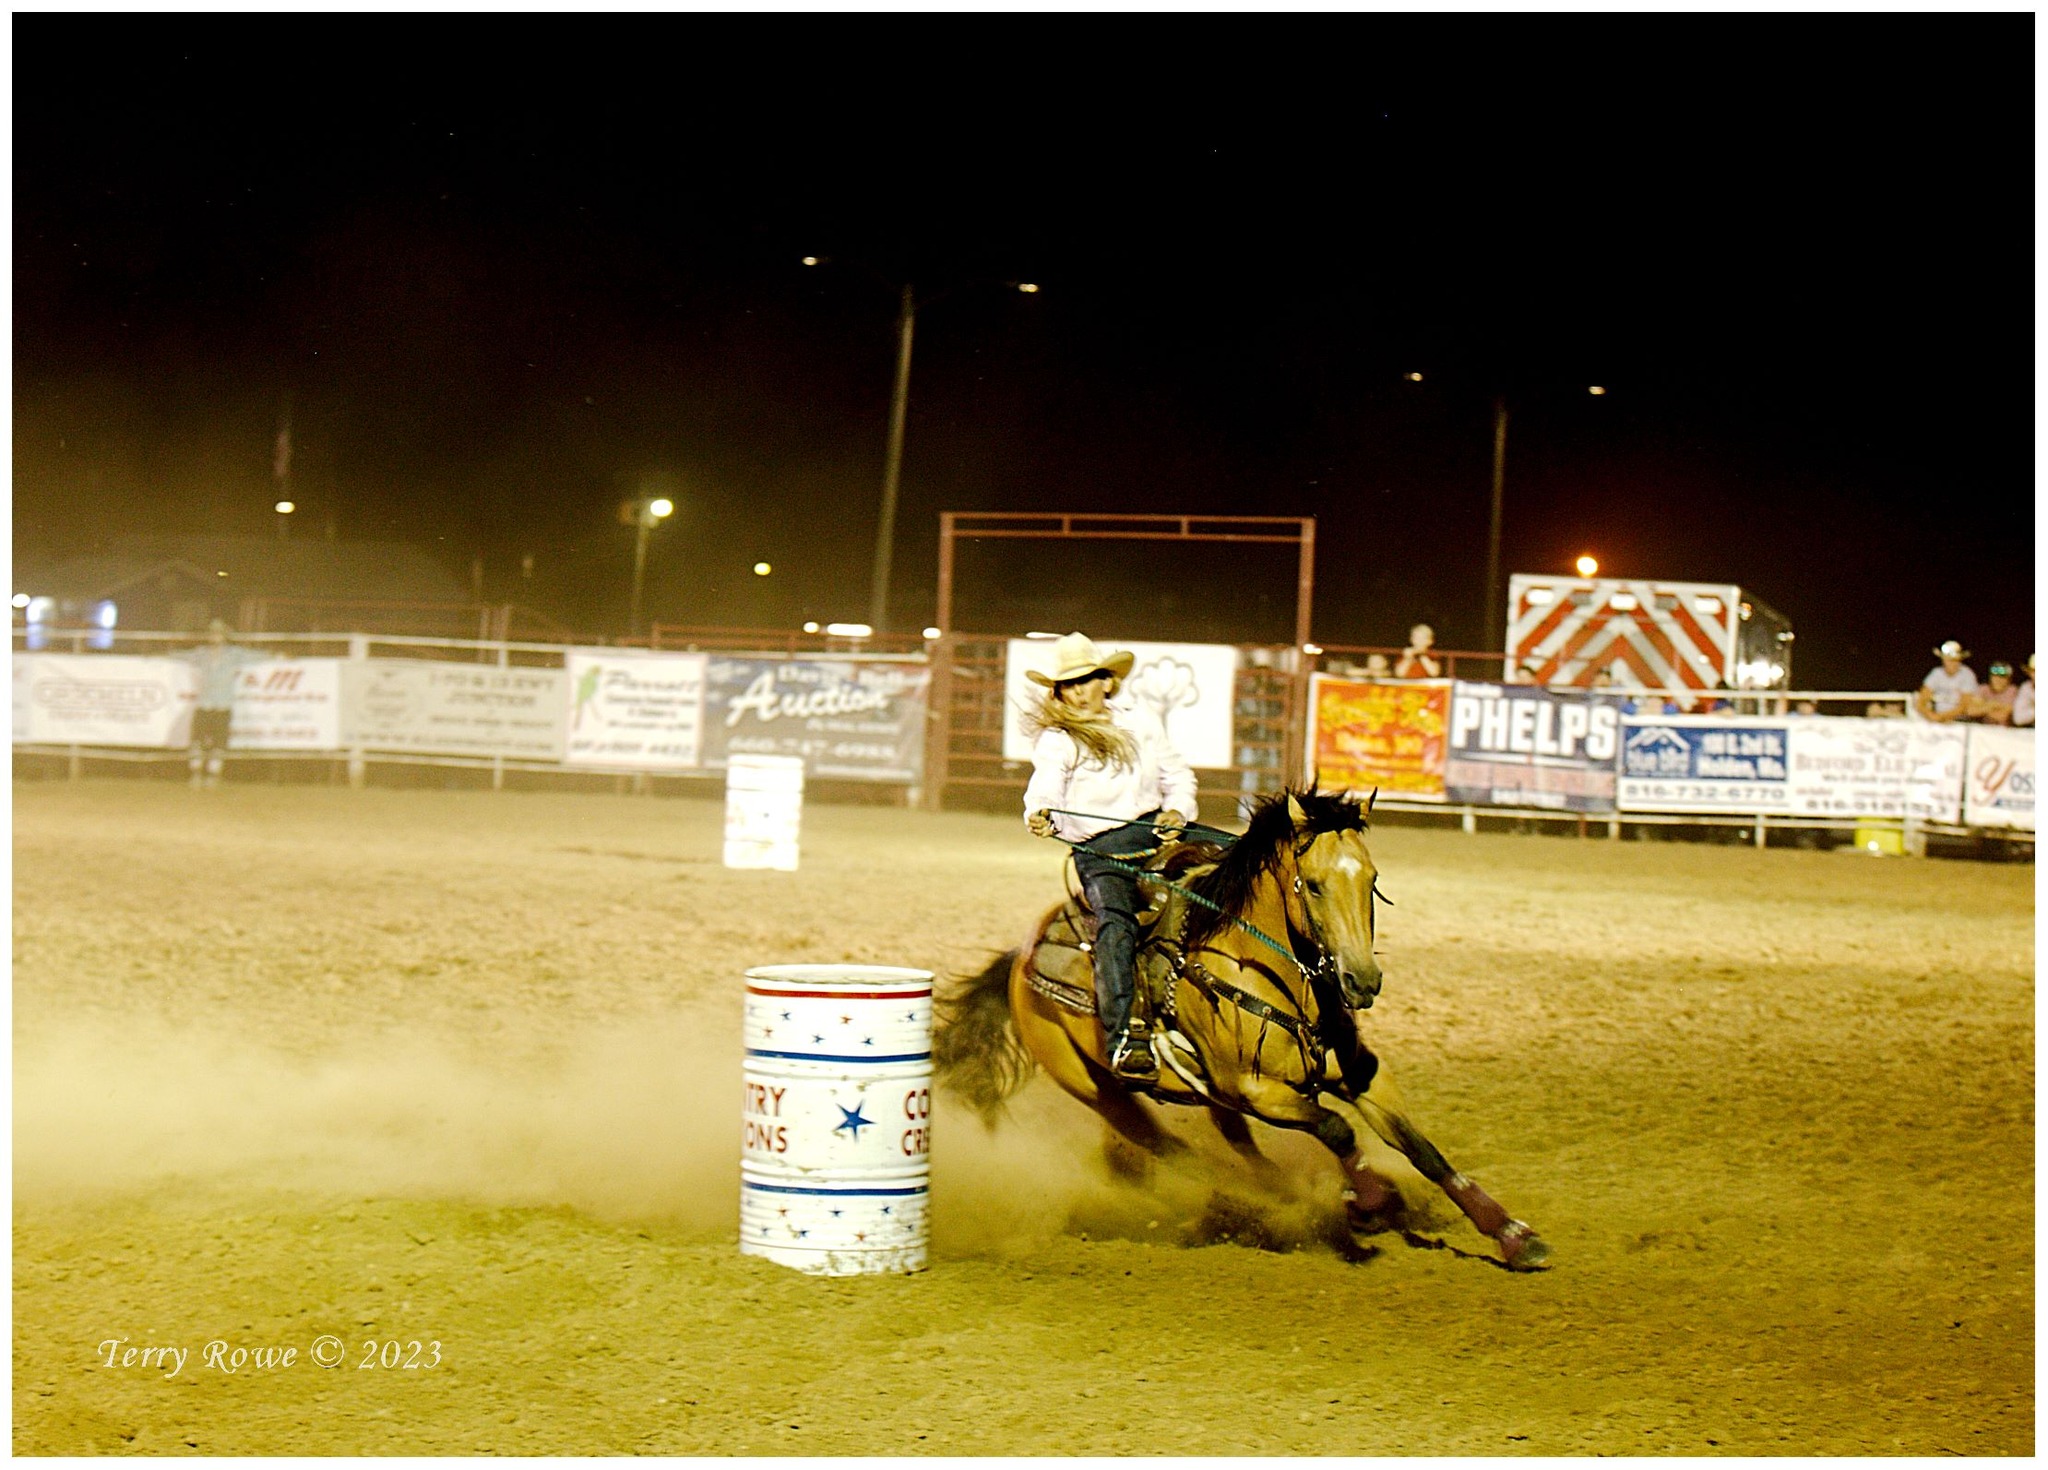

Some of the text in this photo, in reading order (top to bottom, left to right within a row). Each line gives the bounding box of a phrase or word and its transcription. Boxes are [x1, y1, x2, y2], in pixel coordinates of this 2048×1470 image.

[725, 669, 888, 728] Auction
[1451, 697, 1617, 760] PHELPS
[746, 1121, 787, 1153] ONS
